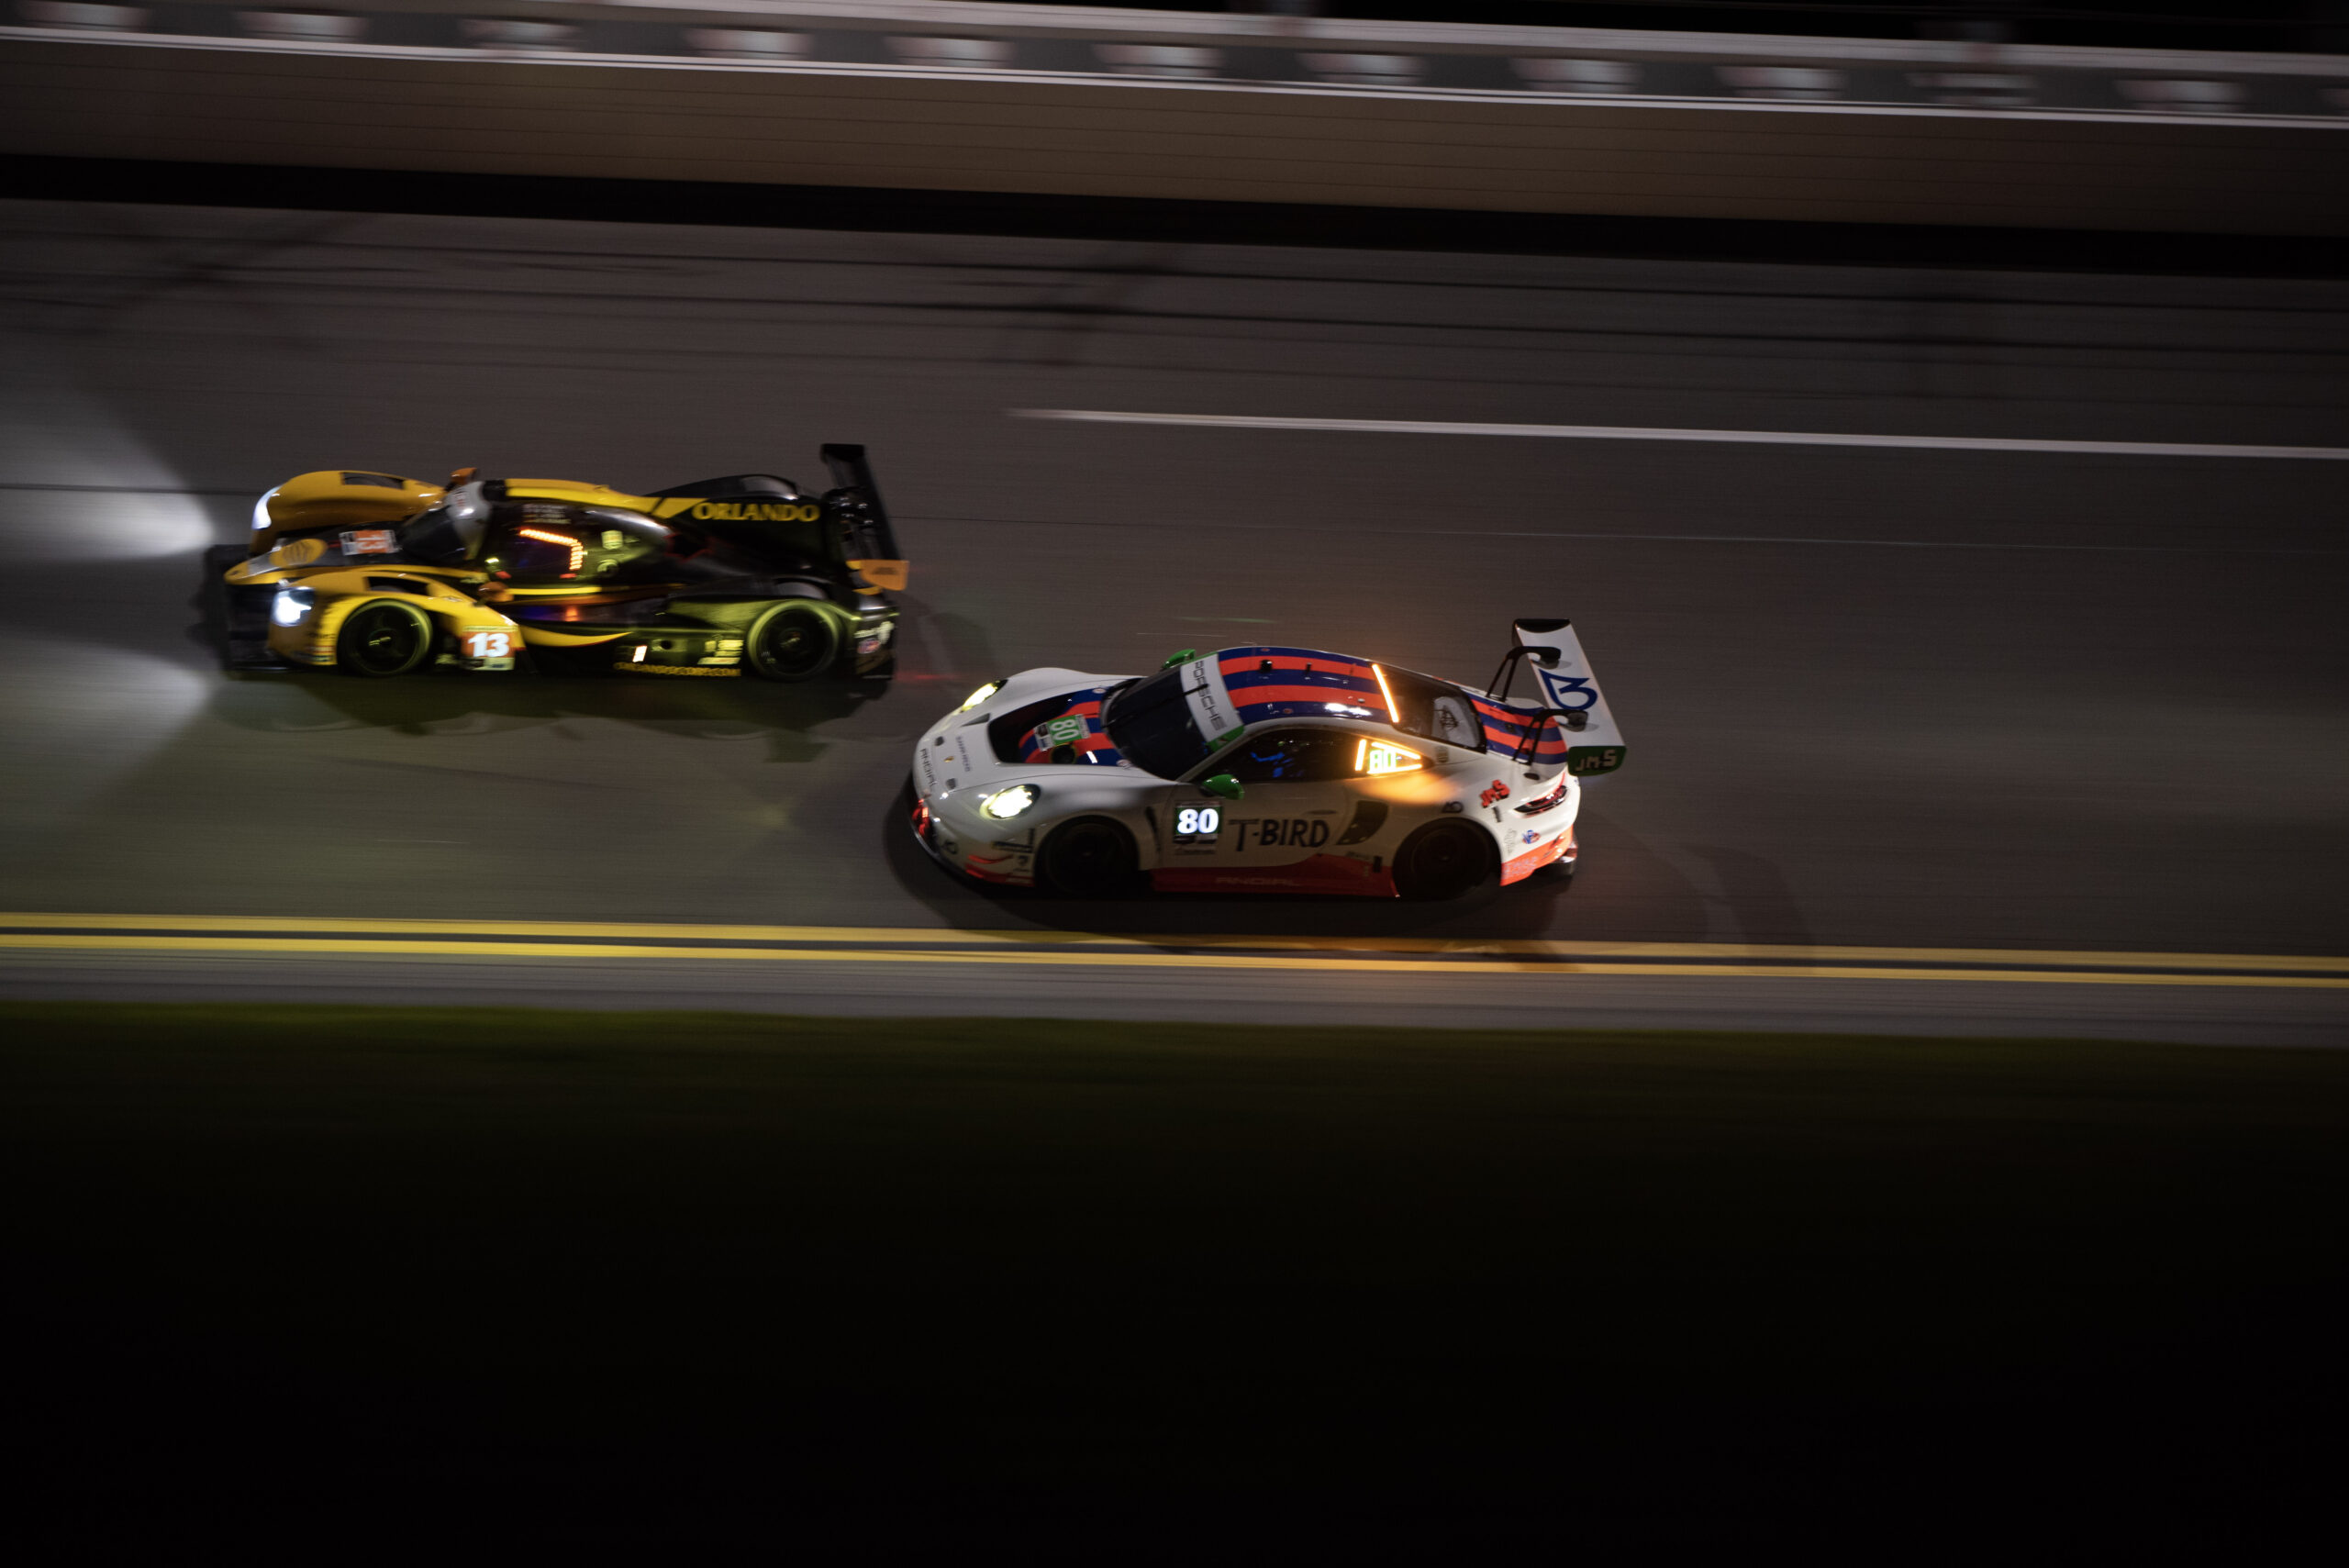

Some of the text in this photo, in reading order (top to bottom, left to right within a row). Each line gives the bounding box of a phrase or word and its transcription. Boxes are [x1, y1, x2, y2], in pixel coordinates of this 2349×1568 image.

[691, 502, 821, 522] ORLANDO
[467, 633, 510, 658] 13
[1194, 660, 1227, 731] PORSCHE
[1050, 718, 1080, 740] 80
[1369, 749, 1397, 771] 80
[1176, 807, 1219, 834] 80
[1228, 818, 1329, 851] T-BIRD
